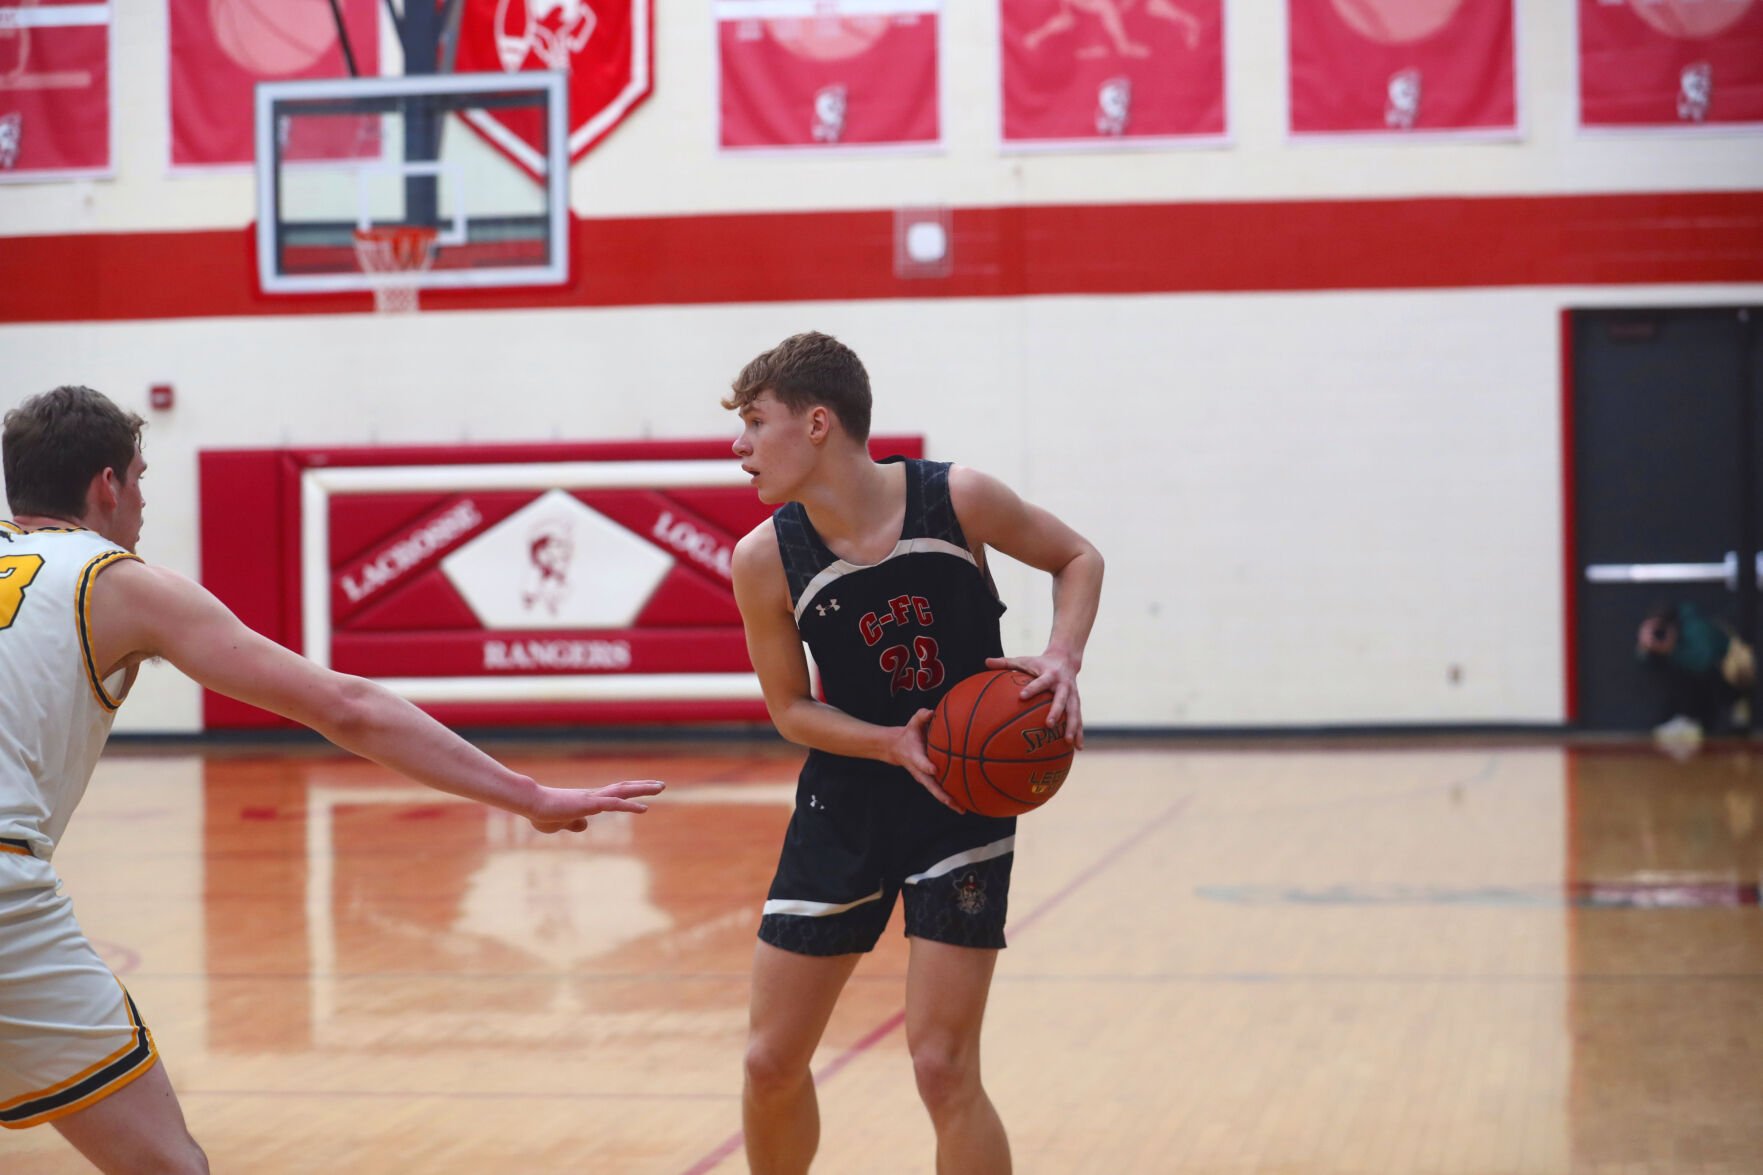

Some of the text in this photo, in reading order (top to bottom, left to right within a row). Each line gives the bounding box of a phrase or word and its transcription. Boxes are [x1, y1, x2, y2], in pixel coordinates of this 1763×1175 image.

[340, 499, 483, 602] LACROSSE
[859, 595, 933, 646] C-FC
[483, 640, 632, 669] RANGERS
[879, 636, 945, 697] 23
